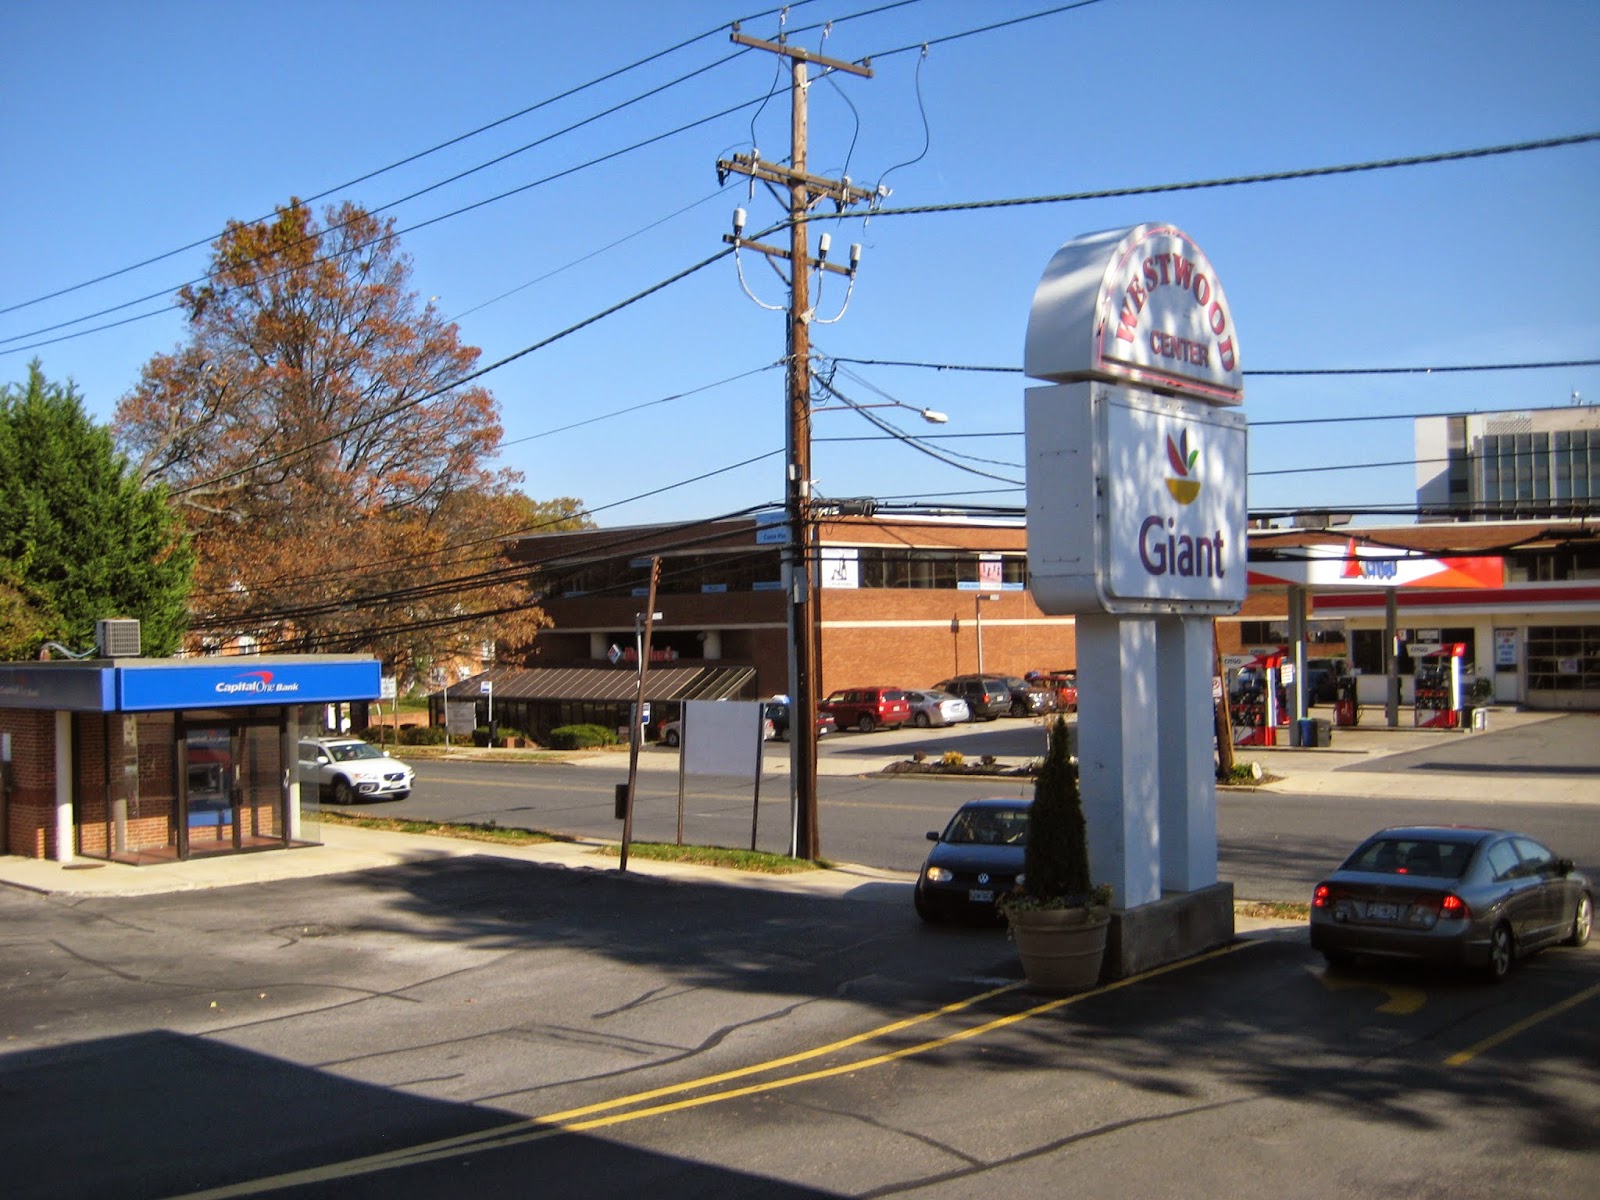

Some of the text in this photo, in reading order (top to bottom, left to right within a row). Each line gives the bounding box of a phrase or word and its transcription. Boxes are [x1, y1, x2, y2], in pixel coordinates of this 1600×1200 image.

[1115, 252, 1235, 373] WESTWOOD
[1149, 329, 1210, 369] CENTER
[1138, 514, 1226, 579] Giant
[276, 682, 299, 692] Bank
